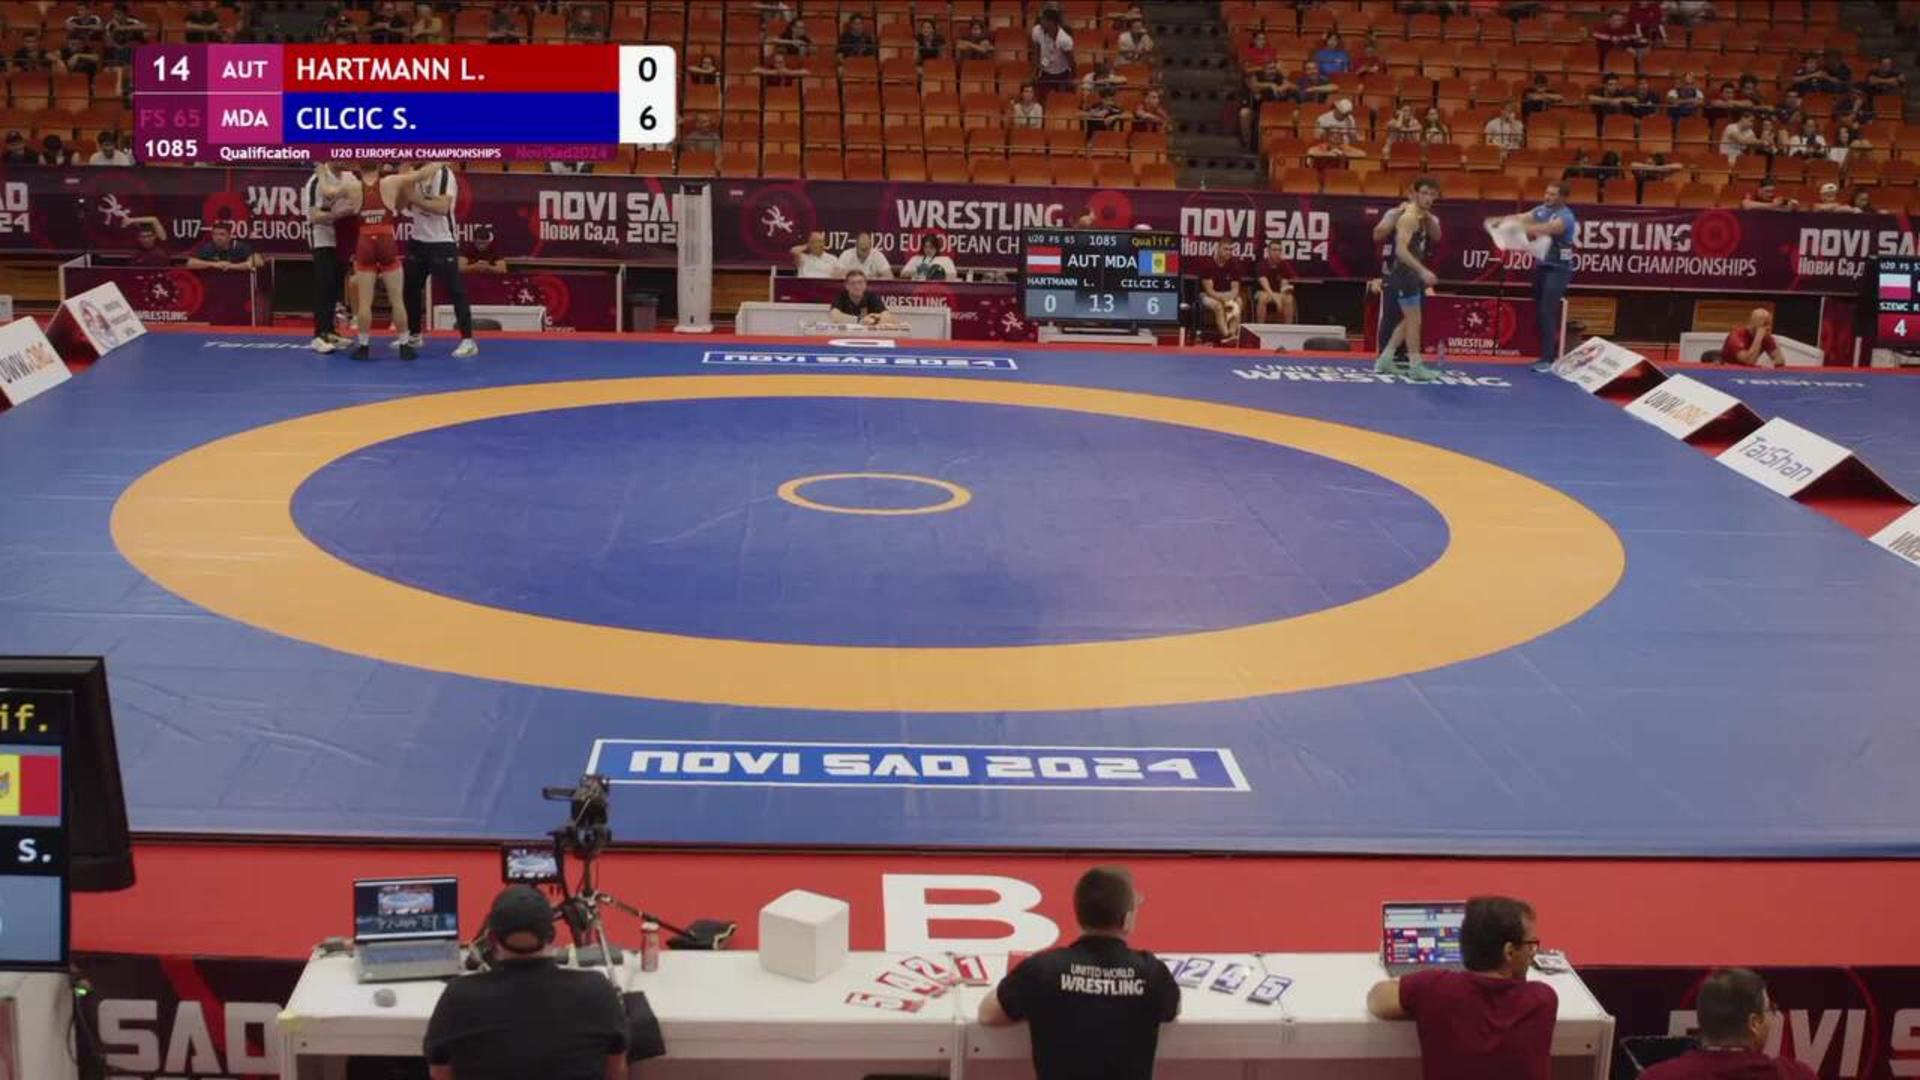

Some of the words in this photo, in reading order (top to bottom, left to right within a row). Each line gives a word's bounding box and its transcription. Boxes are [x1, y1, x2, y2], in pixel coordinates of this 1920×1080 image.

[539, 191, 617, 221] NOVI
[627, 192, 678, 221] SA
[897, 199, 1064, 231] WRESTLING
[540, 221, 579, 240] Нови
[584, 222, 619, 244] Сад
[627, 222, 677, 243] 202
[1180, 208, 1256, 237] NOVI
[1265, 210, 1329, 240] SAD
[901, 233, 991, 254] EUOPEAN
[1089, 235, 1117, 246] 1085
[1132, 237, 1176, 248] Qualif.
[1264, 240, 1328, 261] 024
[1799, 228, 1870, 257] NOVI
[1878, 231, 1920, 256] SA
[1067, 254, 1100, 268] AUT
[1105, 255, 1137, 268] MDA
[1627, 255, 1757, 277] CHAMPIONSHIPS
[1027, 278, 1077, 286] HARTMANN
[1120, 279, 1158, 288] CILCIC
[1044, 295, 1057, 313] 0
[1089, 294, 1115, 313] 13
[1147, 297, 1160, 315] 6
[1894, 319, 1907, 336] 4
[1732, 437, 1813, 482] TaiShan
[629, 750, 800, 775] NOVI
[822, 753, 970, 778] SAD
[986, 754, 1199, 781] 2024
[882, 873, 1060, 953] B
[1071, 963, 1100, 976] UNITED
[1103, 965, 1135, 977] WORLD
[1061, 974, 1144, 996] WRESTLING
[98, 998, 284, 1075] SAD
